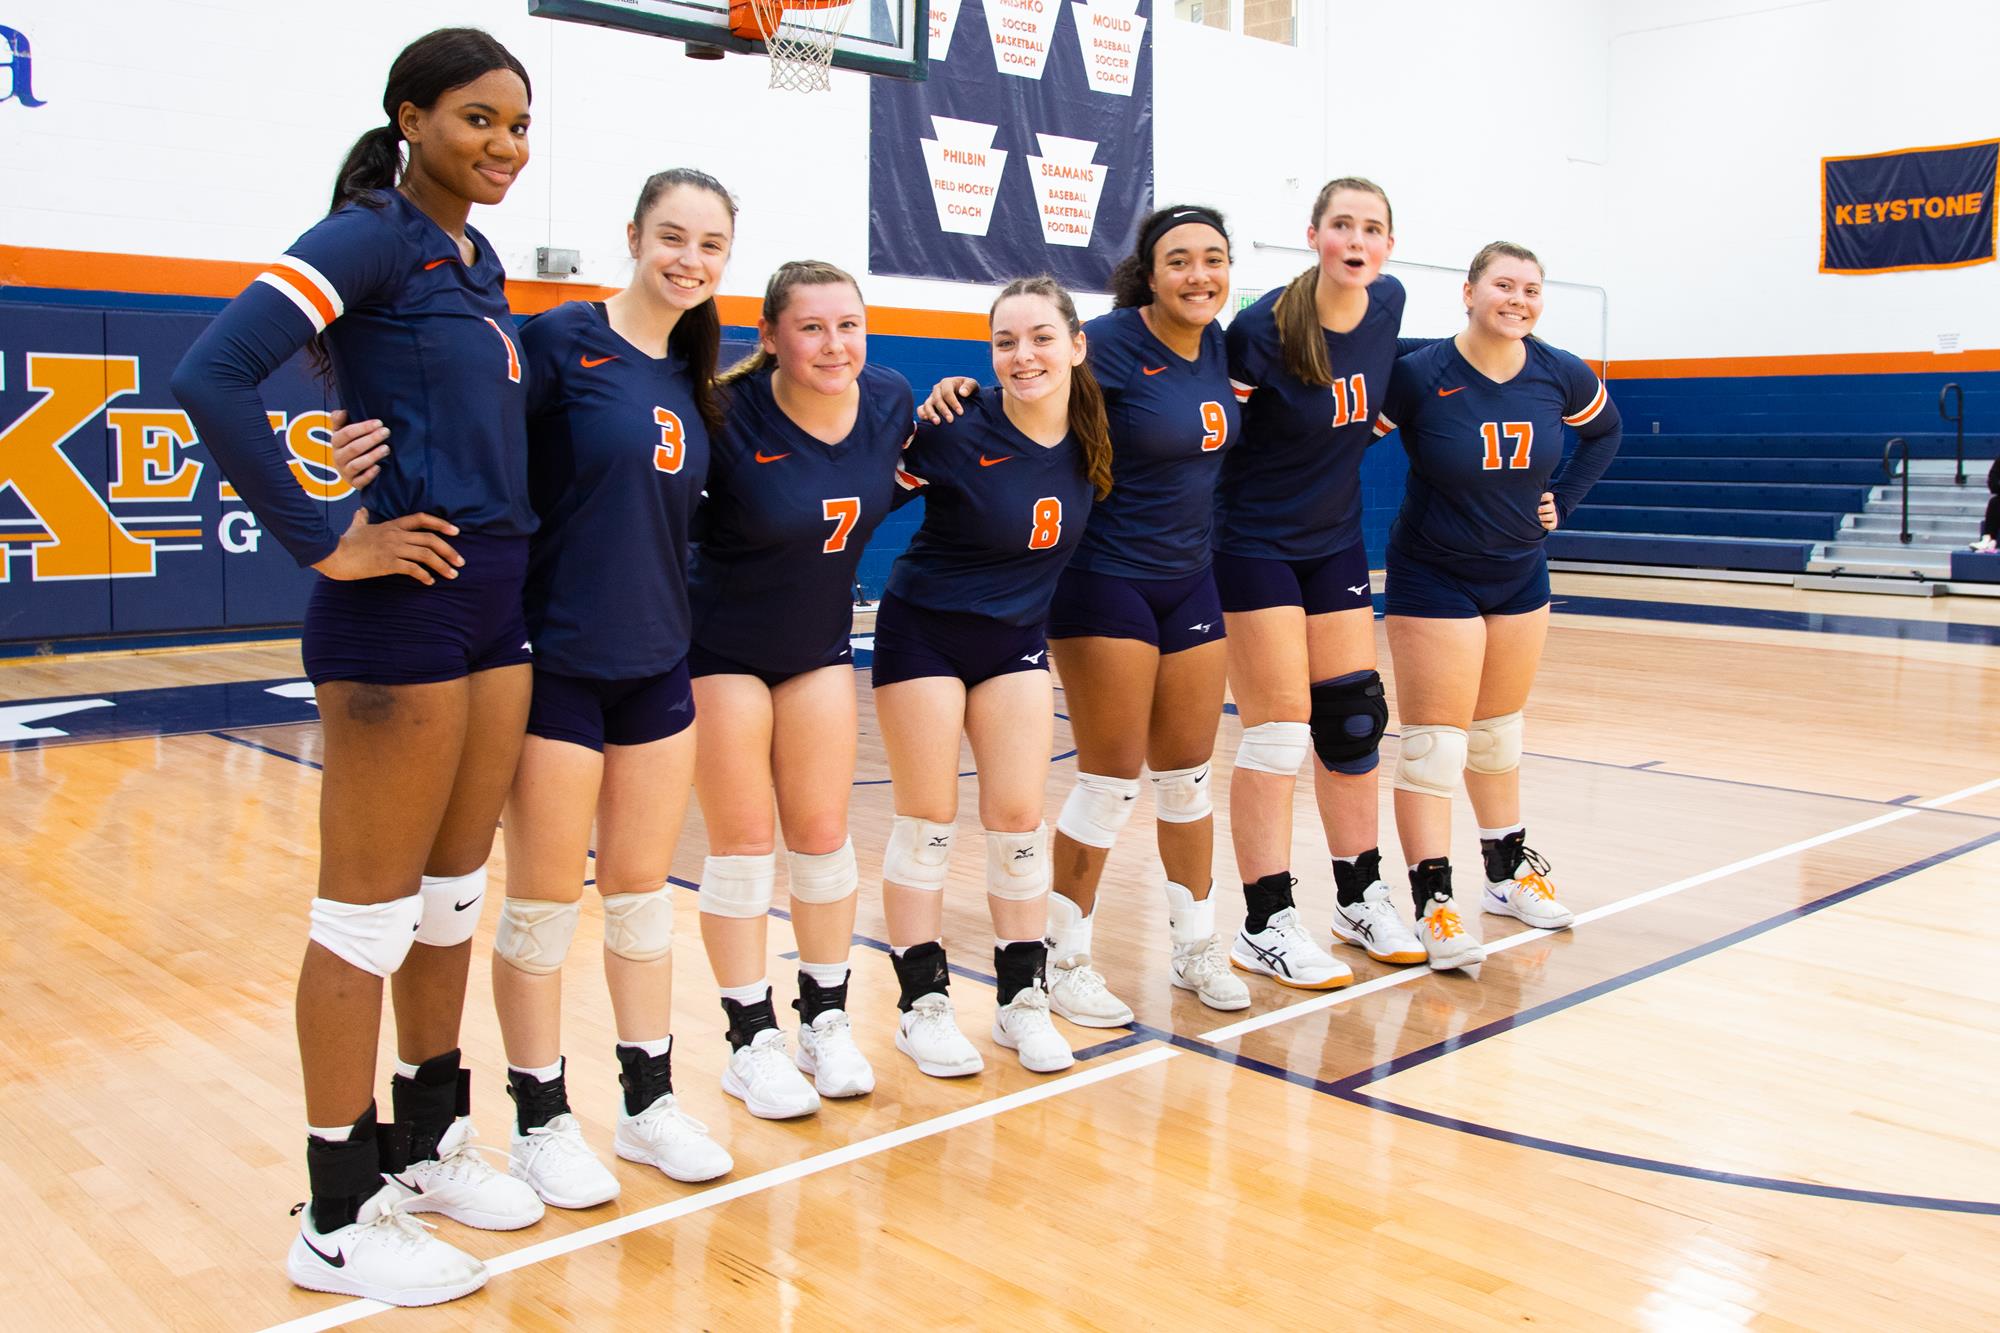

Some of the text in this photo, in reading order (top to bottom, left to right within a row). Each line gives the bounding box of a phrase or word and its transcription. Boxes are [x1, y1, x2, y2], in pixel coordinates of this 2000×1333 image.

[1002, 17, 1037, 33] SOCCER
[1093, 14, 1131, 32] MOULD
[996, 34, 1044, 52] BASKETBALL
[1093, 38, 1131, 53] BASEBALL
[1003, 52, 1036, 67] COACH
[1095, 54, 1129, 68] SOCCER
[1096, 70, 1128, 84] COACH
[943, 149, 986, 167] PHILBIN
[1041, 163, 1094, 182] SEAMANS
[934, 179, 994, 196] FIELD HOCKEY
[1049, 188, 1087, 202] BASEBALL
[947, 203, 981, 217] COACH
[1044, 205, 1091, 219] BASKETBALL
[1835, 192, 1983, 225] KEYSTONE
[1047, 221, 1088, 235] FOOTBALL
[1332, 373, 1368, 428] 11
[1200, 400, 1228, 452] 9
[653, 406, 686, 475] 3
[1480, 421, 1534, 470] 17
[822, 497, 860, 553] 7
[1028, 497, 1062, 550] 8
